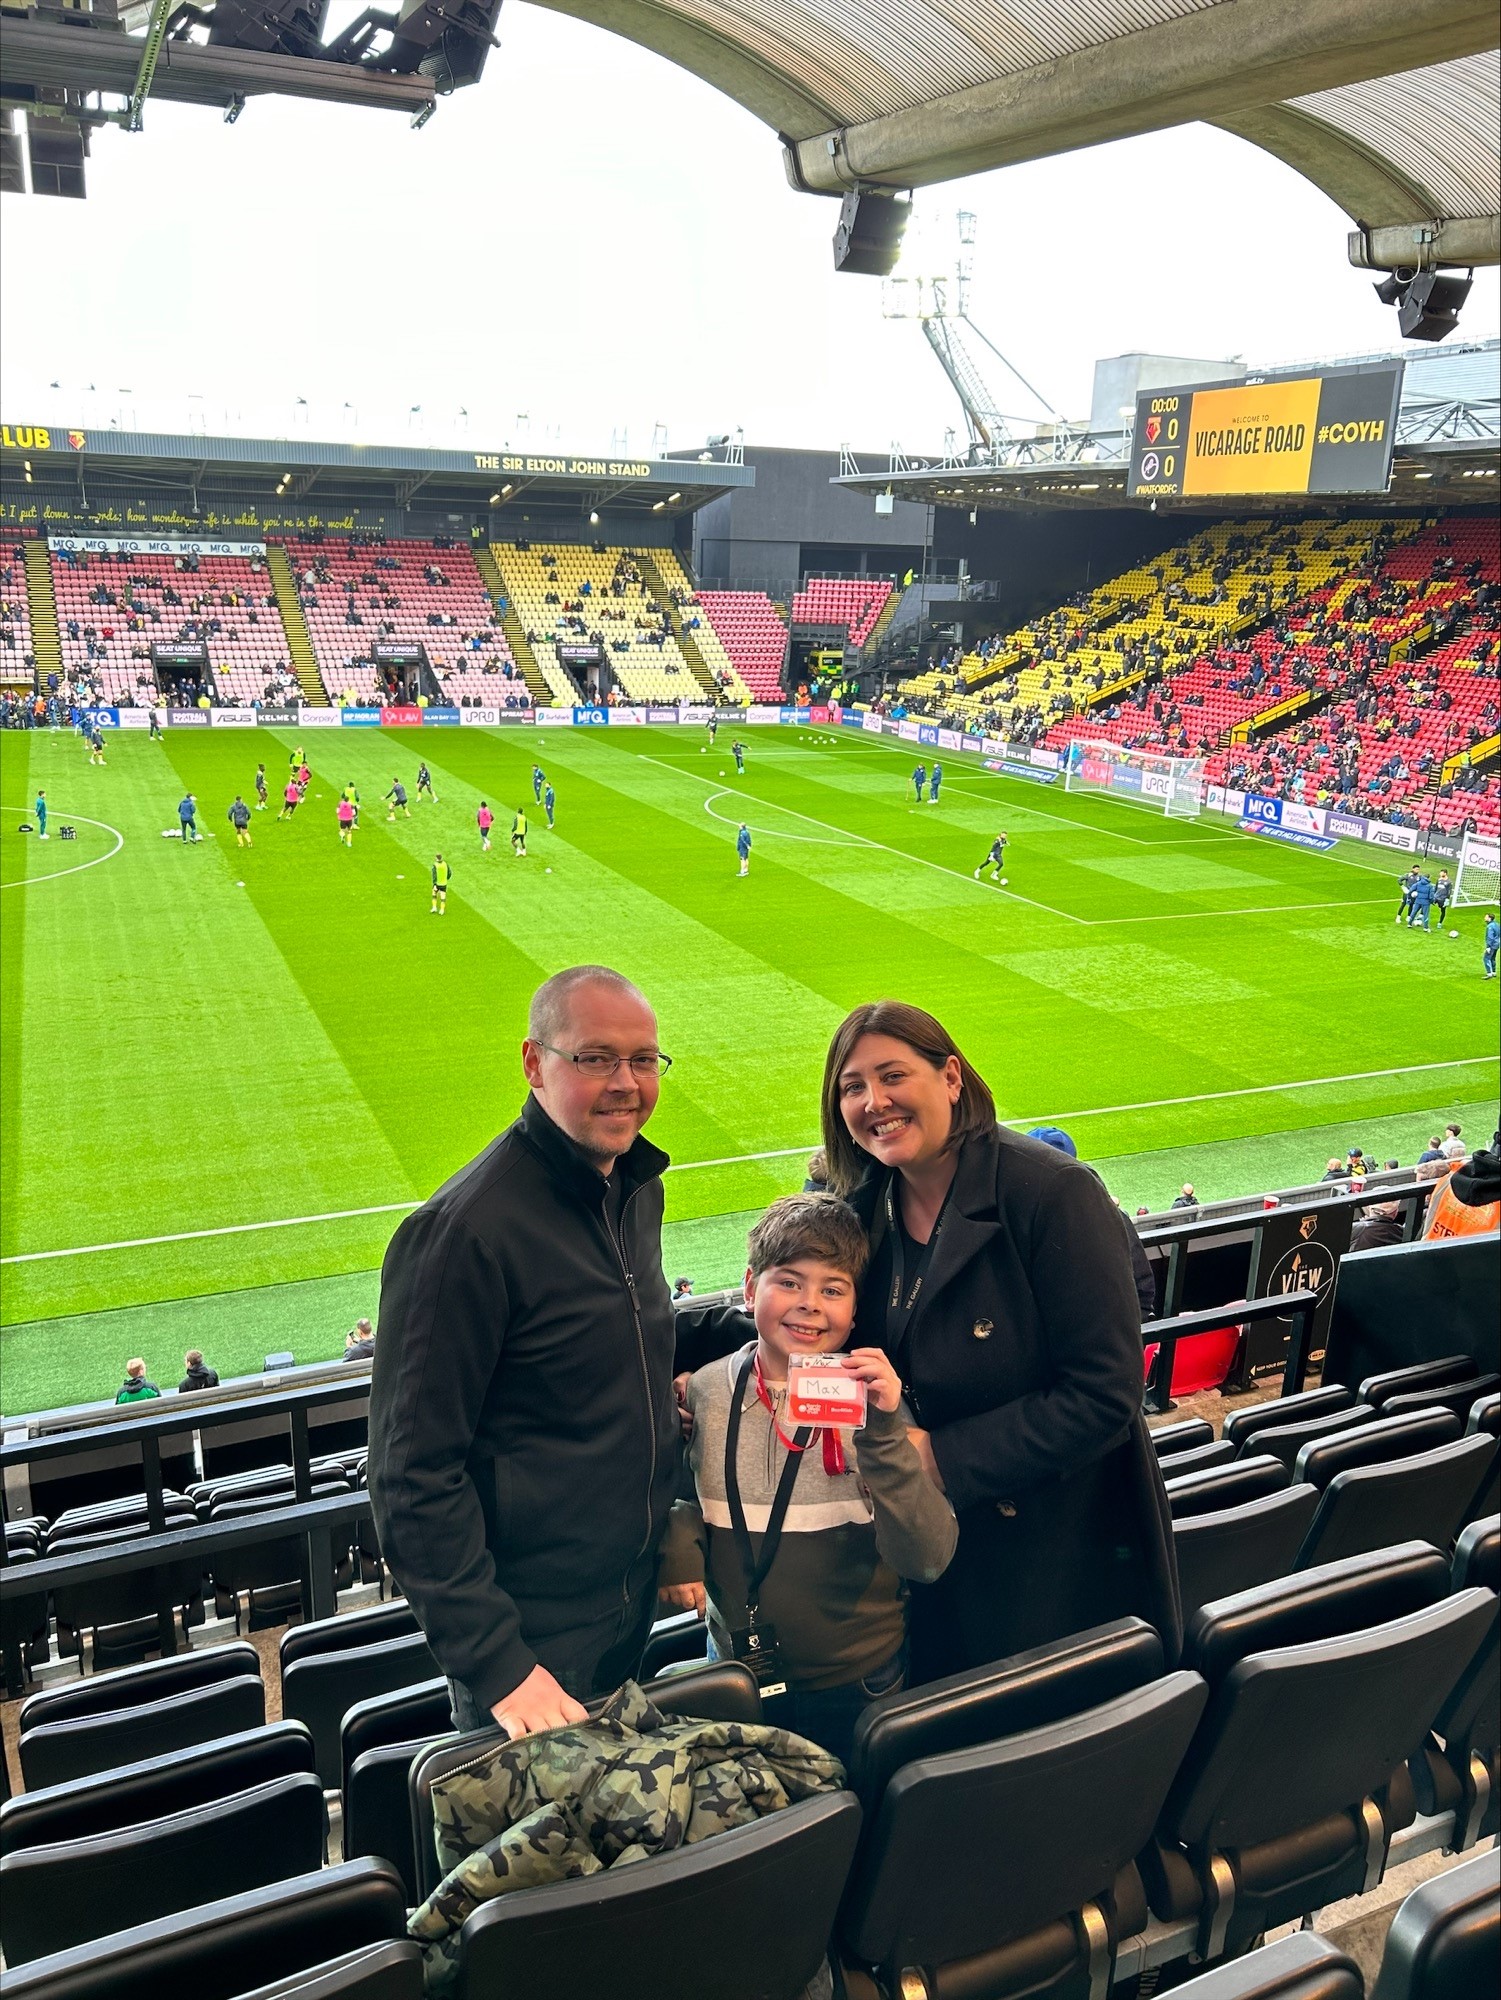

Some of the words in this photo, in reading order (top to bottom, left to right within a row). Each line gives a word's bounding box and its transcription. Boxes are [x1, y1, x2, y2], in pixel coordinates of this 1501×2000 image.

[1152, 397, 1179, 413] 00:00
[1232, 415, 1260, 424] WELCOME
[1261, 414, 1270, 422] TO
[0, 425, 51, 449] LUB
[1167, 418, 1179, 441] 0
[1317, 420, 1384, 444] #COYH
[1195, 426, 1261, 457] VICARAGE
[1264, 423, 1305, 453] ROAD
[475, 455, 499, 469] THE
[502, 456, 523, 471] SIR
[526, 458, 566, 473] ELTON
[569, 460, 607, 475] JOHN
[609, 462, 651, 477] STAND
[1164, 455, 1175, 477] 0
[1136, 483, 1178, 495] #WATFORDFC
[9, 504, 17, 517] I
[19, 505, 37, 522] put
[43, 504, 70, 519] down
[127, 508, 147, 522] how
[222, 514, 231, 525] is
[234, 511, 259, 526] while
[53, 539, 77, 549] MrQ
[86, 540, 108, 550] MrQ
[118, 541, 141, 551] MrQ
[149, 542, 172, 552] MrQ
[210, 544, 232, 554] MrQ
[240, 545, 262, 554] MrQ
[217, 714, 251, 722] ASUS
[258, 714, 290, 722] KELME
[302, 713, 335, 723] Corpay
[400, 713, 419, 723] LAW
[577, 709, 606, 724] MrQ
[1248, 798, 1278, 820] MrQ
[1372, 830, 1411, 848] ASUS
[910, 1276, 923, 1301] GALLERY
[1282, 1266, 1323, 1294] VIEW
[806, 1380, 841, 1396] Max
